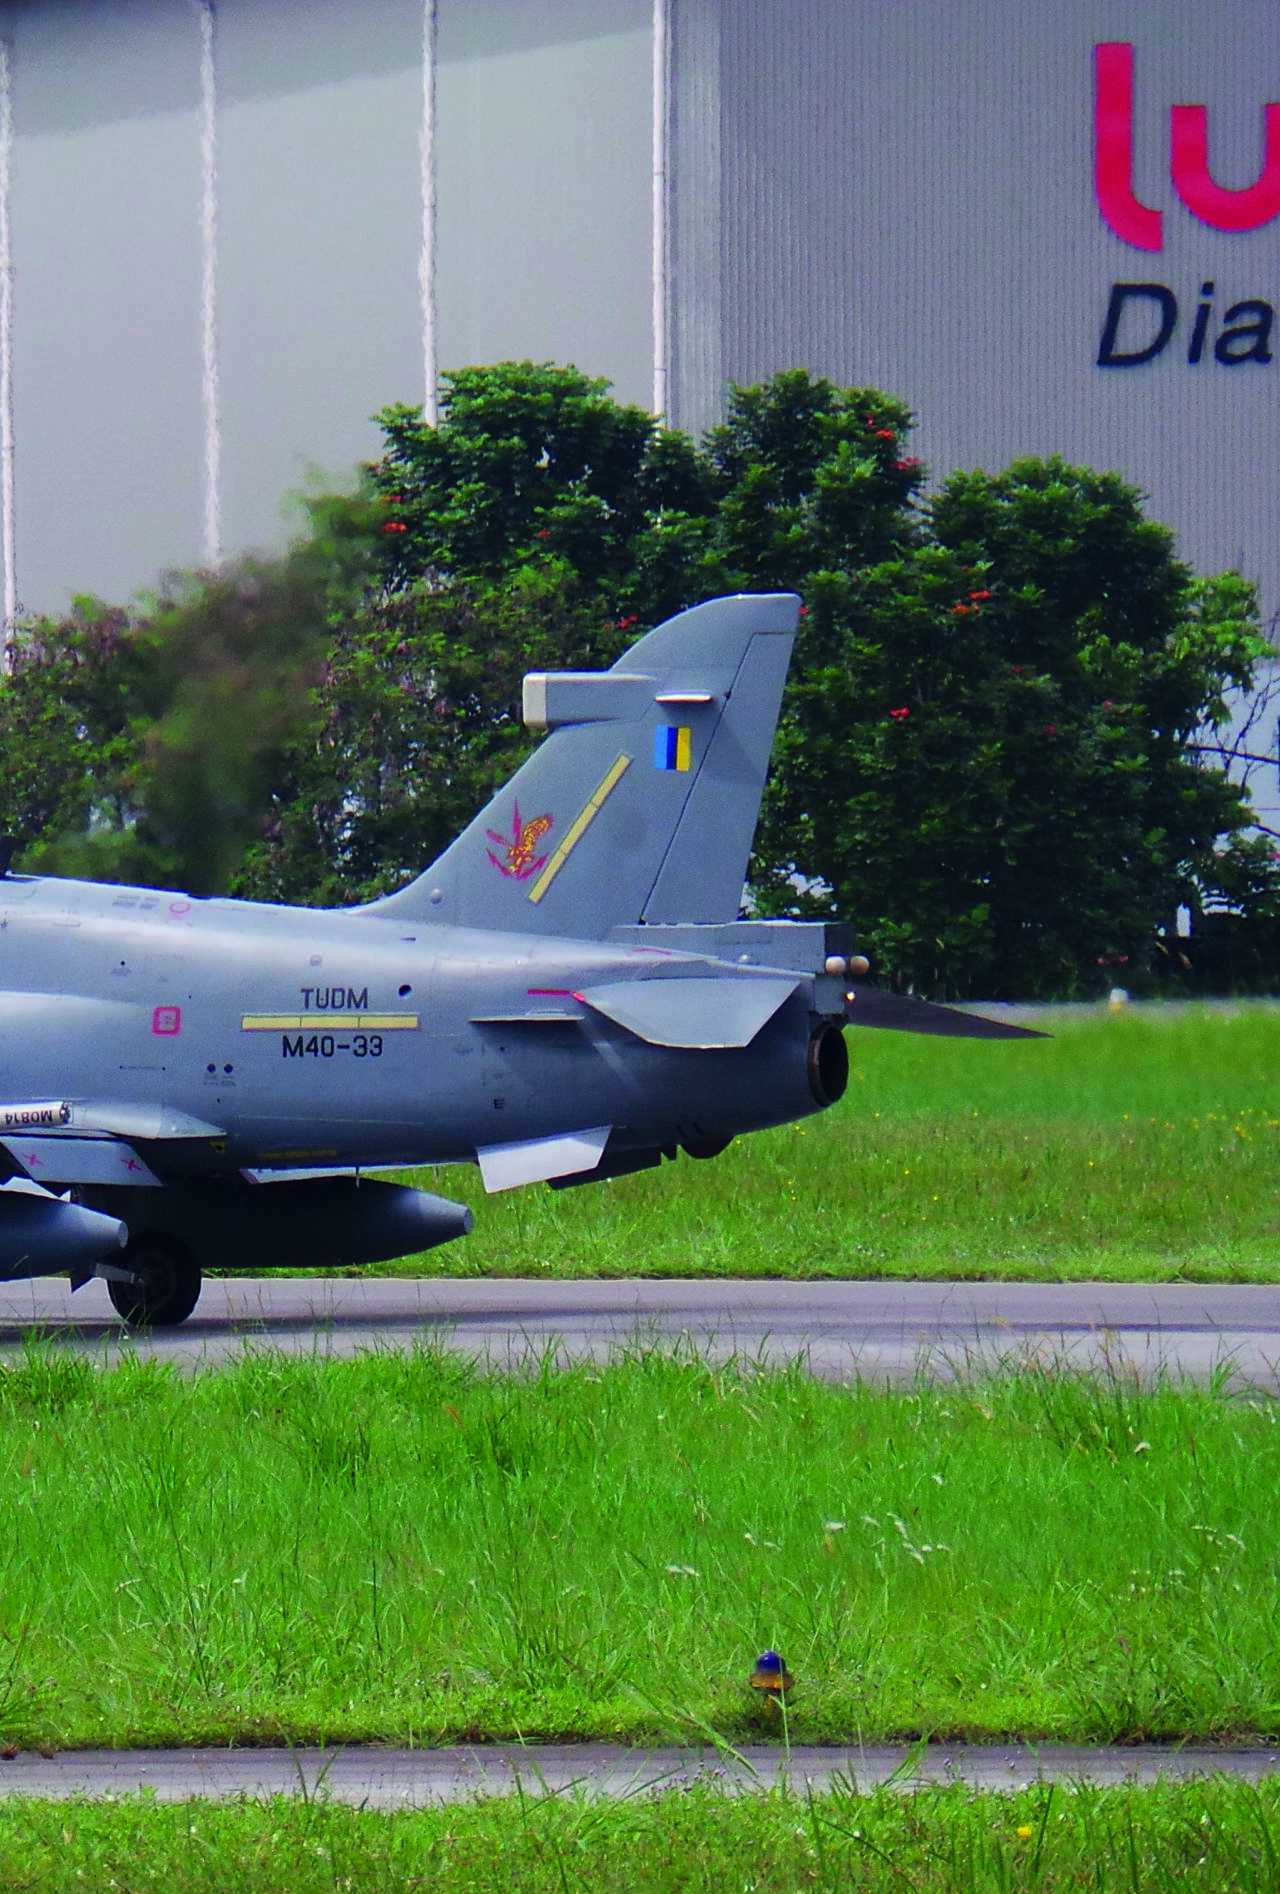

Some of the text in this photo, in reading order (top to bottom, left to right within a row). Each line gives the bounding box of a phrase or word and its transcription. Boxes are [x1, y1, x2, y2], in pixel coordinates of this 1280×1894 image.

[1096, 281, 1274, 367] Dia
[301, 987, 368, 1010] TUDM
[282, 1035, 383, 1058] M40-33
